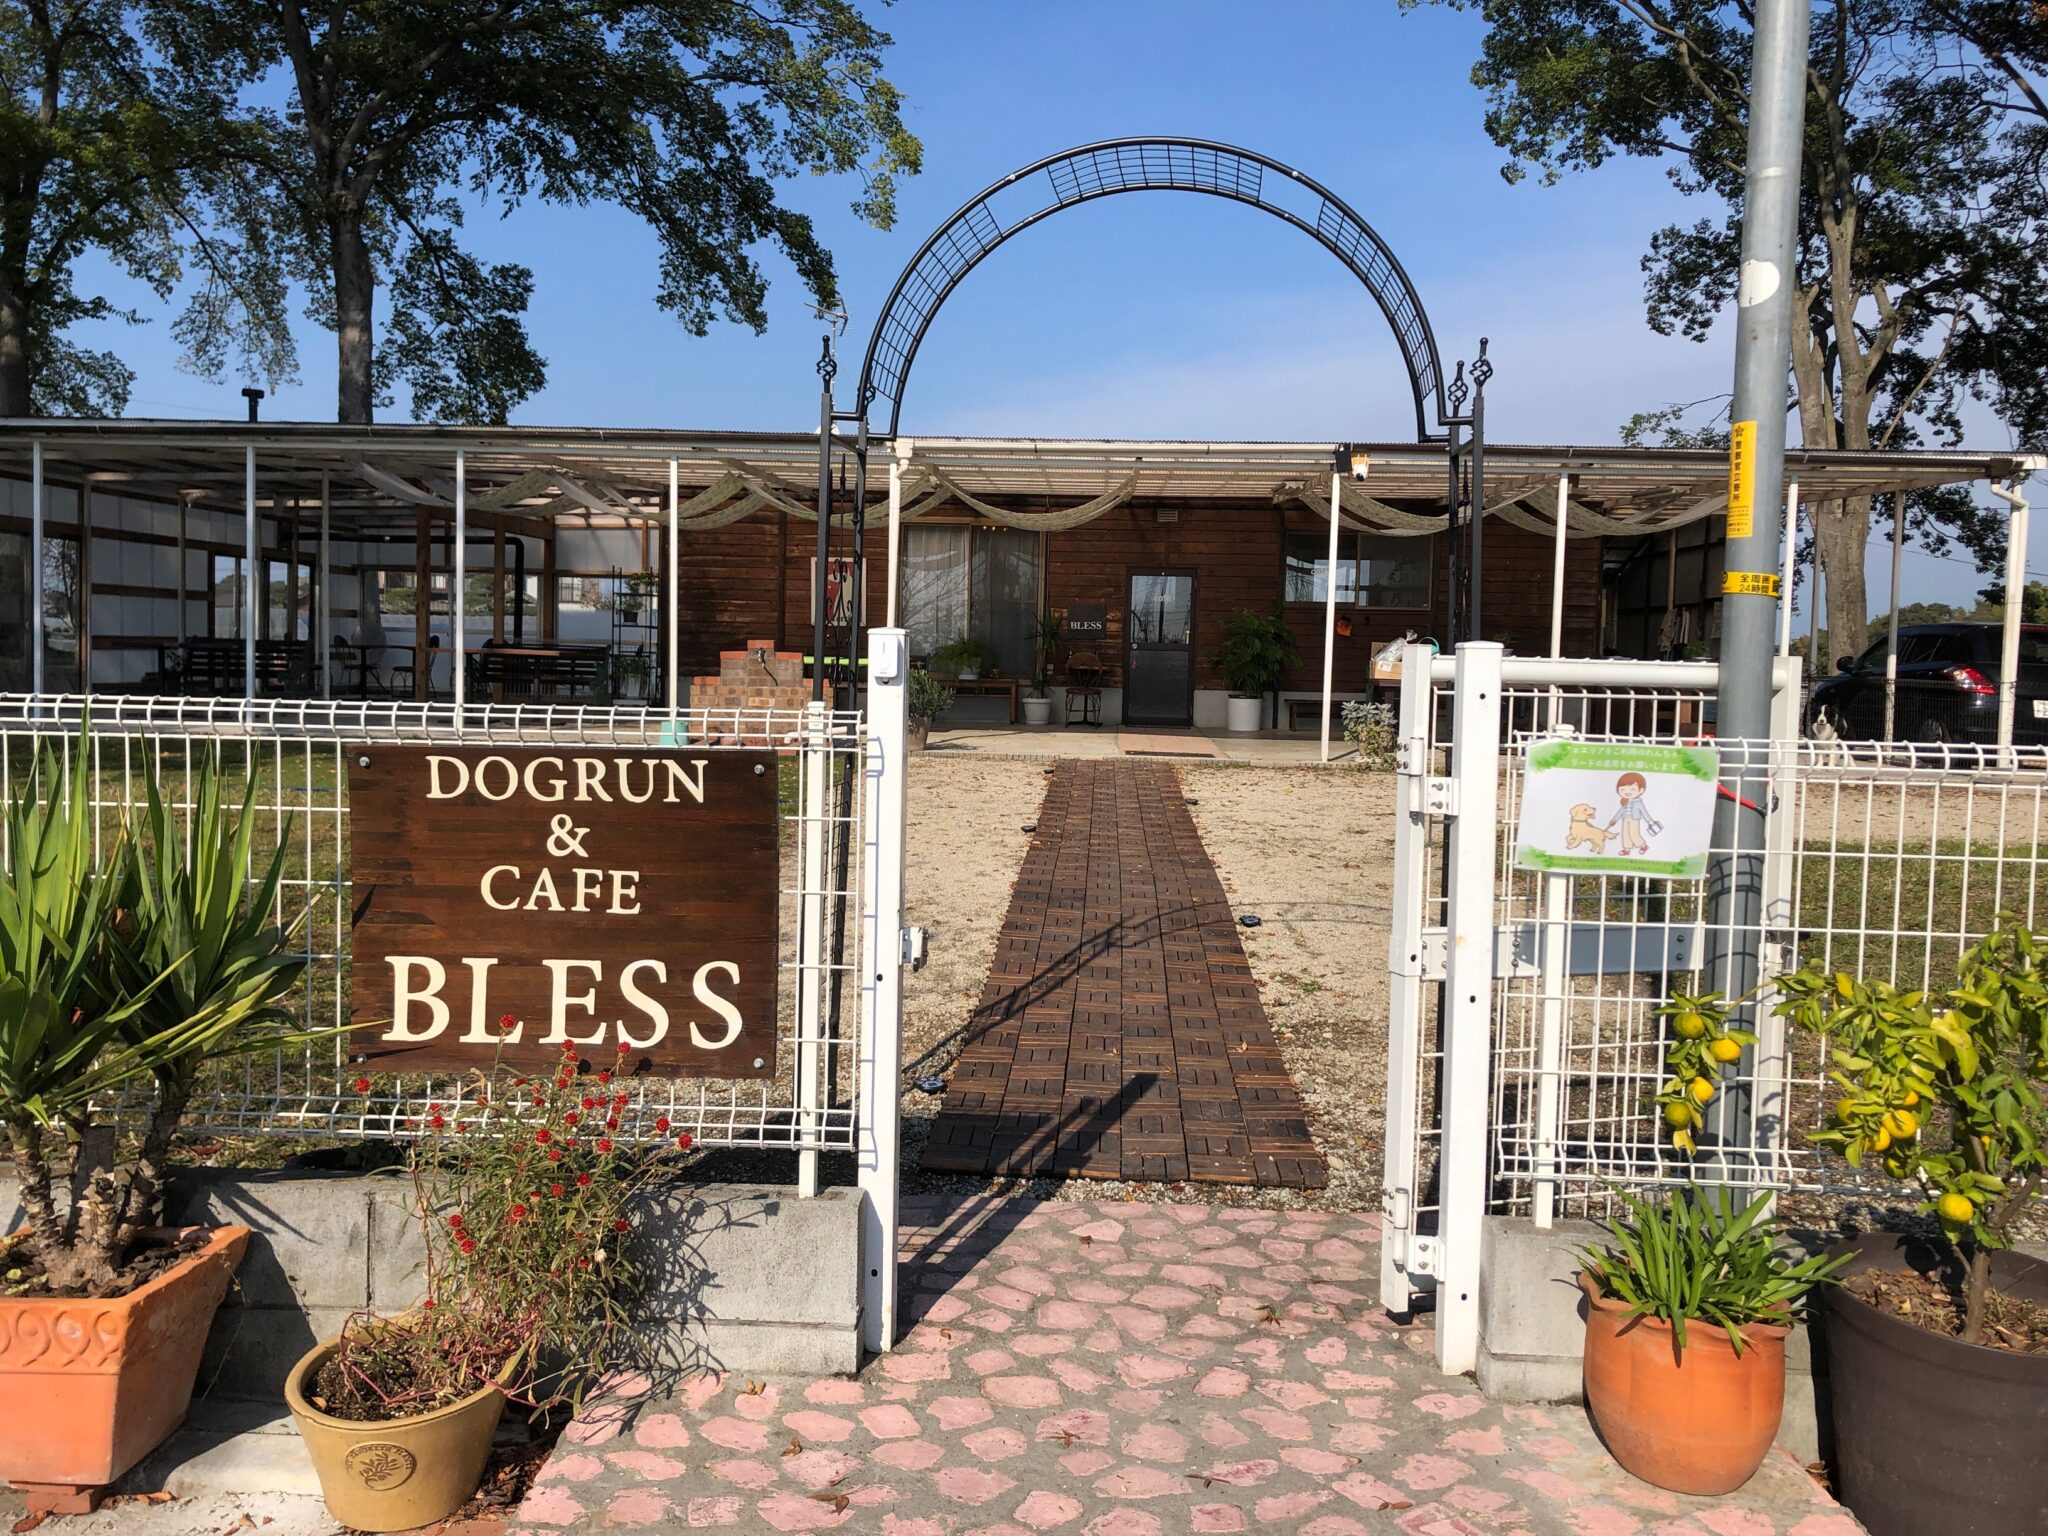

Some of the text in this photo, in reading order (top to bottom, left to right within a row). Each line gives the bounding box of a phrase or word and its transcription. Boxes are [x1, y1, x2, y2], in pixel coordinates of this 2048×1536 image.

[1739, 583, 1769, 594] 24時間
[1070, 621, 1102, 630] BLESS
[425, 755, 709, 803] DOGRUN
[546, 813, 590, 858] &
[480, 865, 641, 915] CAFE
[381, 955, 743, 1050] BLESS
